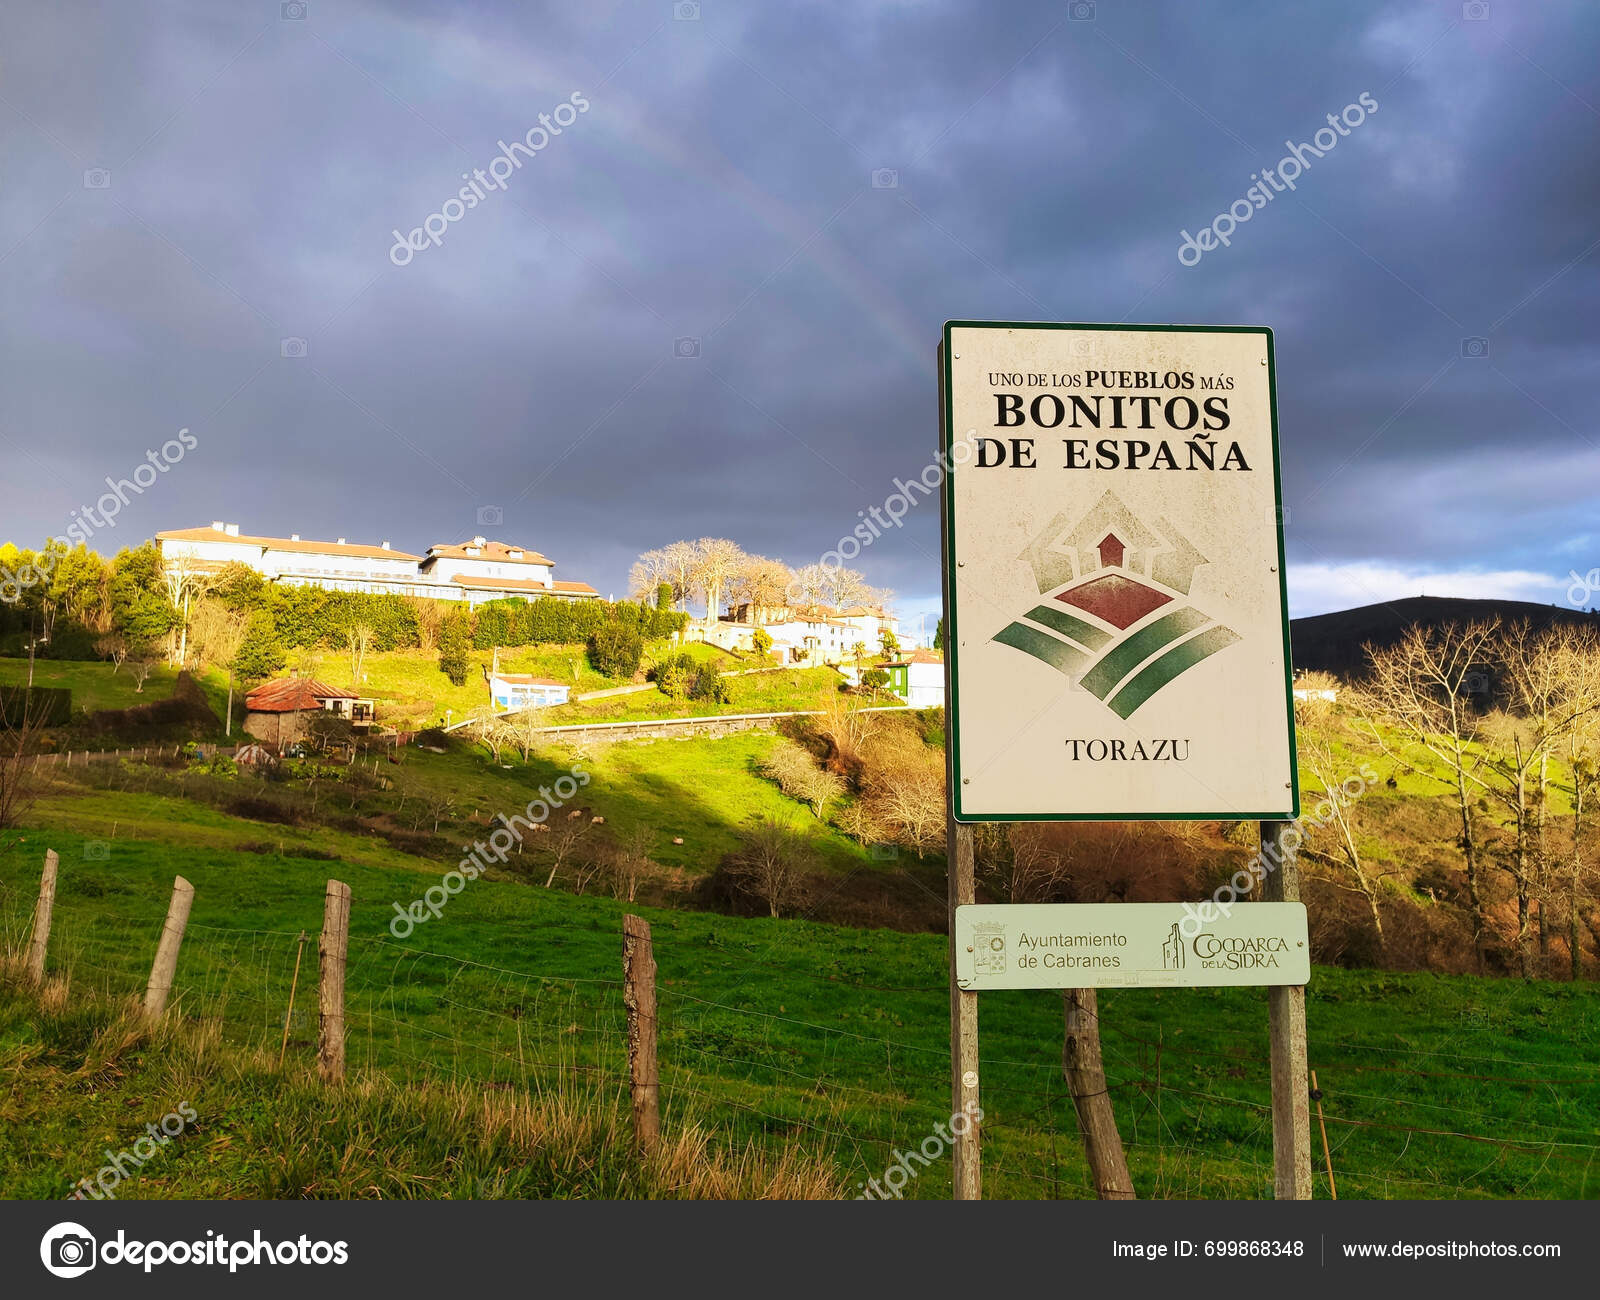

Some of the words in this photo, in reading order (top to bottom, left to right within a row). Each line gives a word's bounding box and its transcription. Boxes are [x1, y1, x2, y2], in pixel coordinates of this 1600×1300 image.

[988, 372, 1024, 387] UNO
[1027, 373, 1048, 388] DE
[1052, 373, 1081, 388] LOS
[1085, 370, 1195, 390] PUEBLOS
[1200, 373, 1234, 390] MÁS
[993, 393, 1231, 431] BONITOS
[974, 437, 1037, 469] DE
[1063, 432, 1252, 471] ESPAÑA
[1065, 738, 1191, 762] TORAZU
[1018, 932, 1127, 951] Ayuntamiento
[1018, 953, 1038, 968] de
[1043, 953, 1121, 968] Cabranes
[1226, 952, 1279, 970] SIDRA
